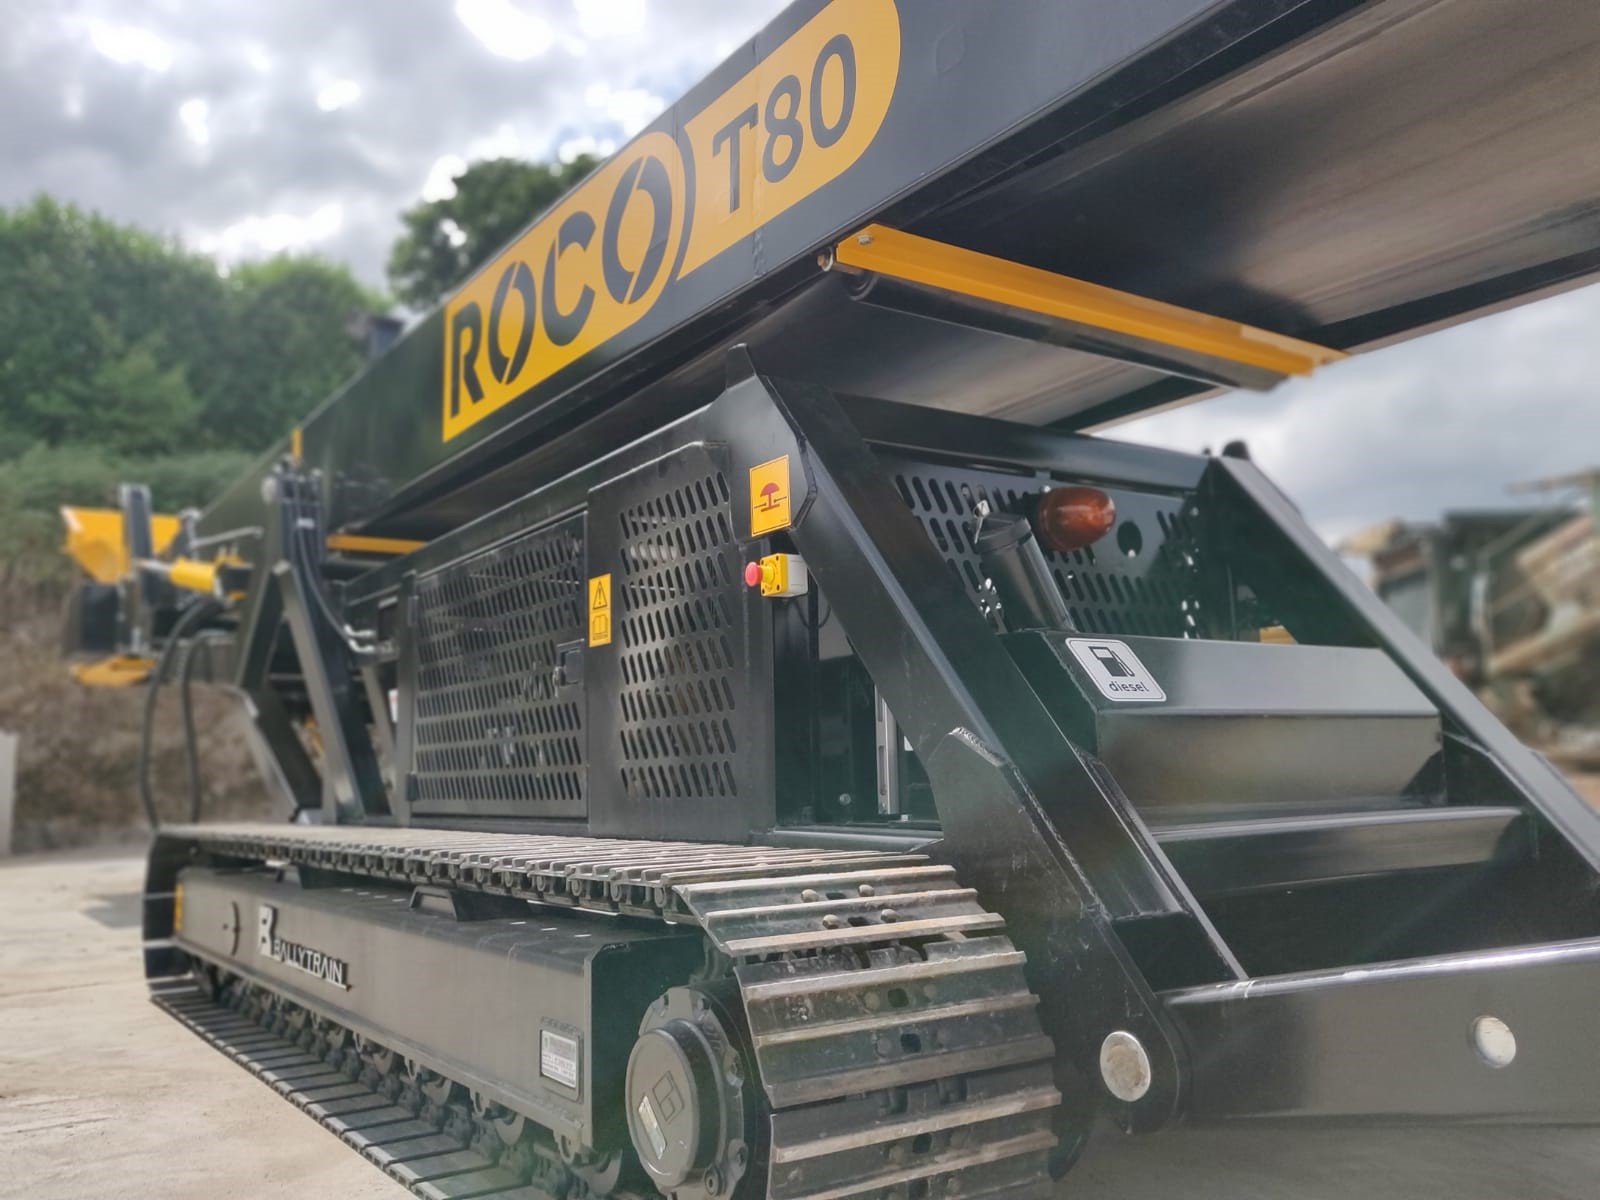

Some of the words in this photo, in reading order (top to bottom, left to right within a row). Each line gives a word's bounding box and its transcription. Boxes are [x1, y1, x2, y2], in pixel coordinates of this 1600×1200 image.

[712, 33, 857, 214] T80
[450, 155, 673, 420] ROCO
[1109, 681, 1149, 692] diesel
[273, 938, 347, 988] BALLYTRAIN
